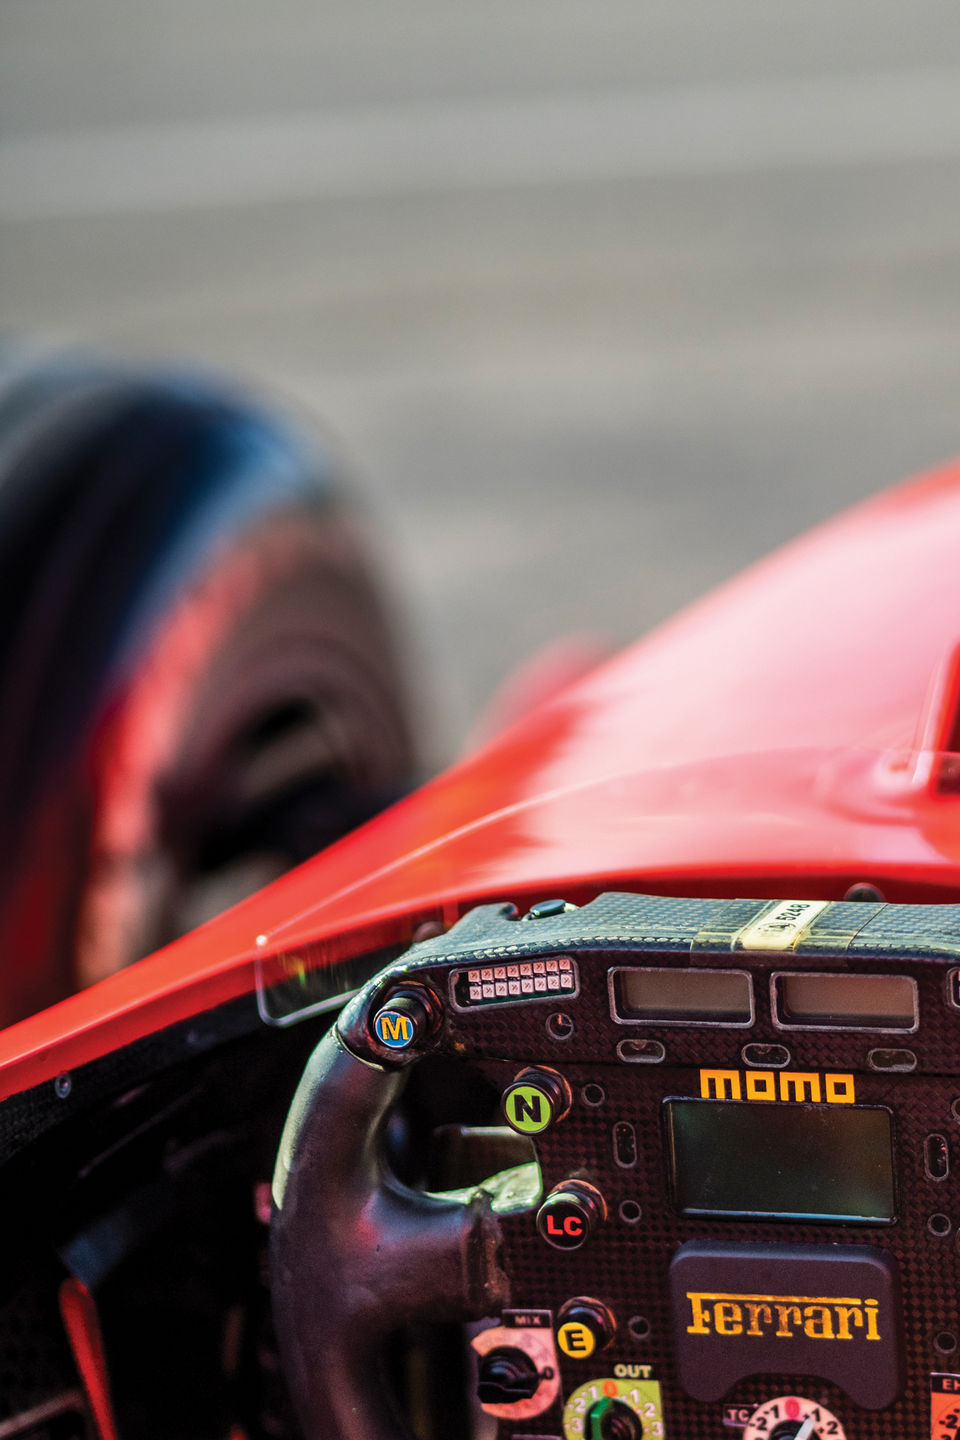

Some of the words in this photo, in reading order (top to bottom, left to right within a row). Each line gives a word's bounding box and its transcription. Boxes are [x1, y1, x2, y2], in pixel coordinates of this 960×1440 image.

[380, 1016, 409, 1041] M
[513, 1094, 542, 1123] N
[546, 1214, 583, 1237] LC
[686, 1291, 882, 1341] Ferrari
[564, 1329, 587, 1351] E
[613, 1363, 652, 1378] OUT
[602, 1379, 619, 1398] 0
[727, 1409, 749, 1422] TC
[784, 1399, 801, 1419] 0
